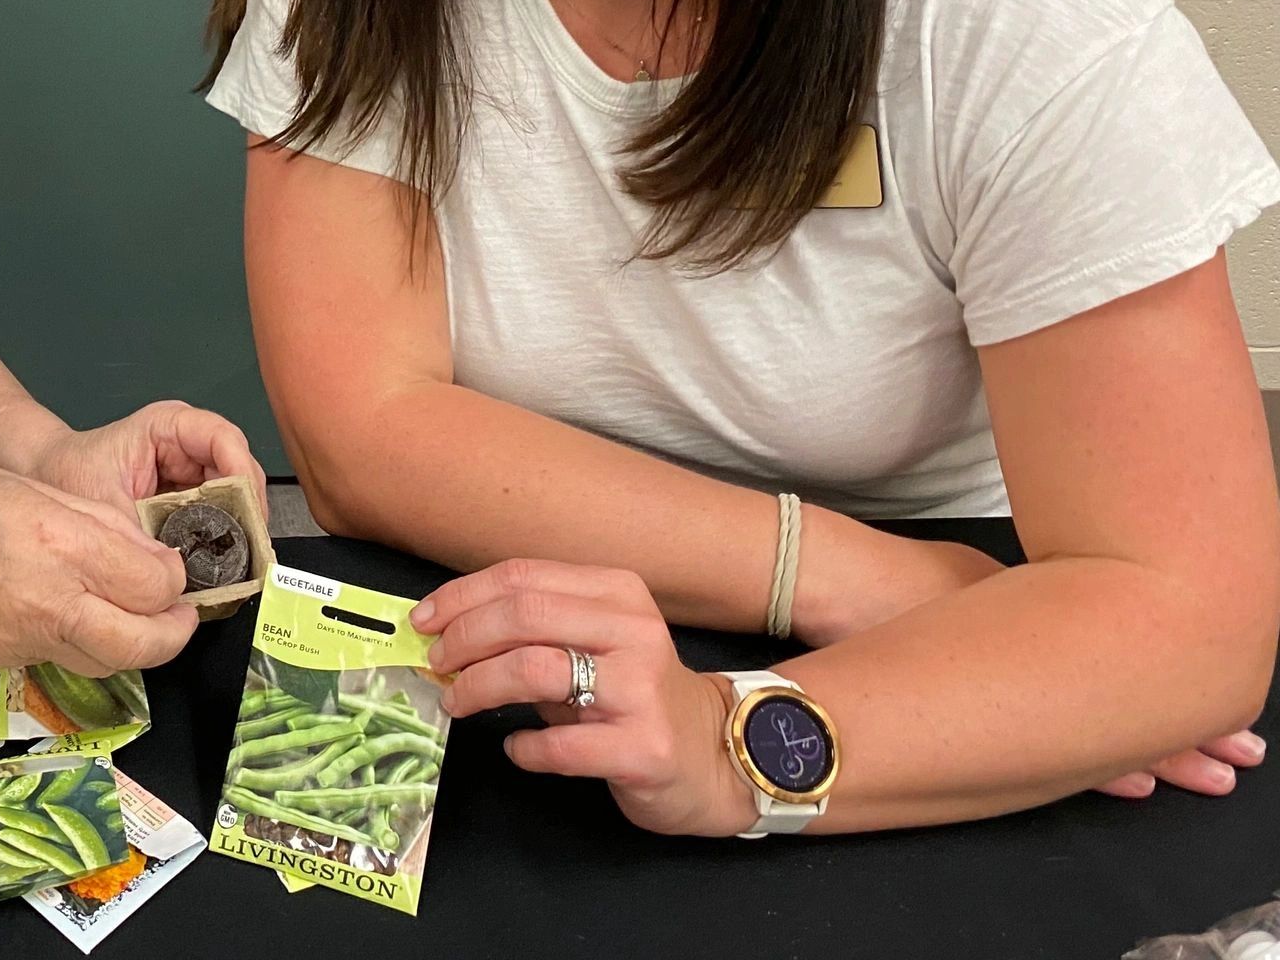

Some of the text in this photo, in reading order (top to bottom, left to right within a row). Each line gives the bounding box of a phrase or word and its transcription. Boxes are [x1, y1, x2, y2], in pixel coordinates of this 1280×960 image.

[277, 574, 333, 597] VEGETABLE
[263, 623, 292, 639] BEAN
[220, 814, 235, 825] GMO
[218, 833, 397, 900] LIVINGSTON
